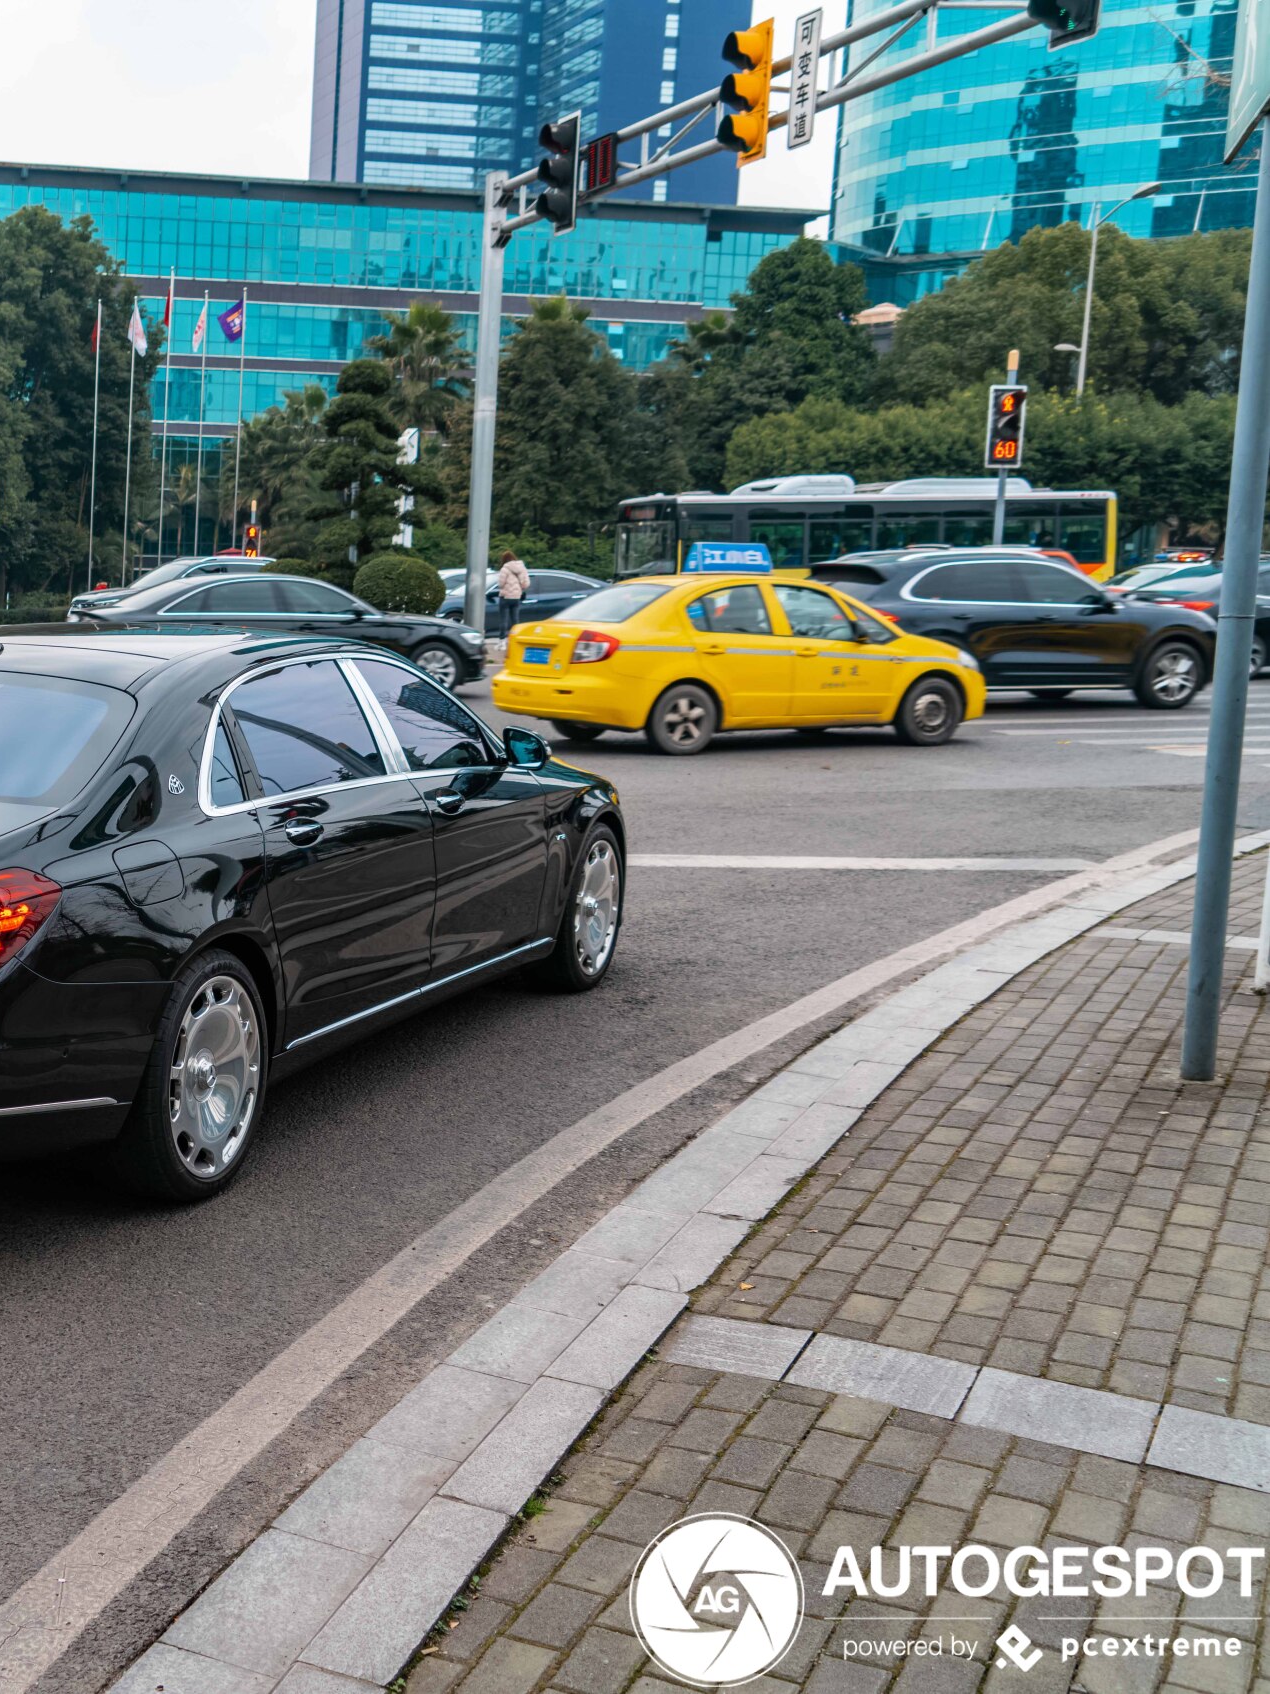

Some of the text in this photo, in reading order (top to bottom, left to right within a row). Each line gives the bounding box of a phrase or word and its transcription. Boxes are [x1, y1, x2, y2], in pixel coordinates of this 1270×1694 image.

[793, 18, 816, 139] 可变车道
[993, 440, 1016, 459] 60
